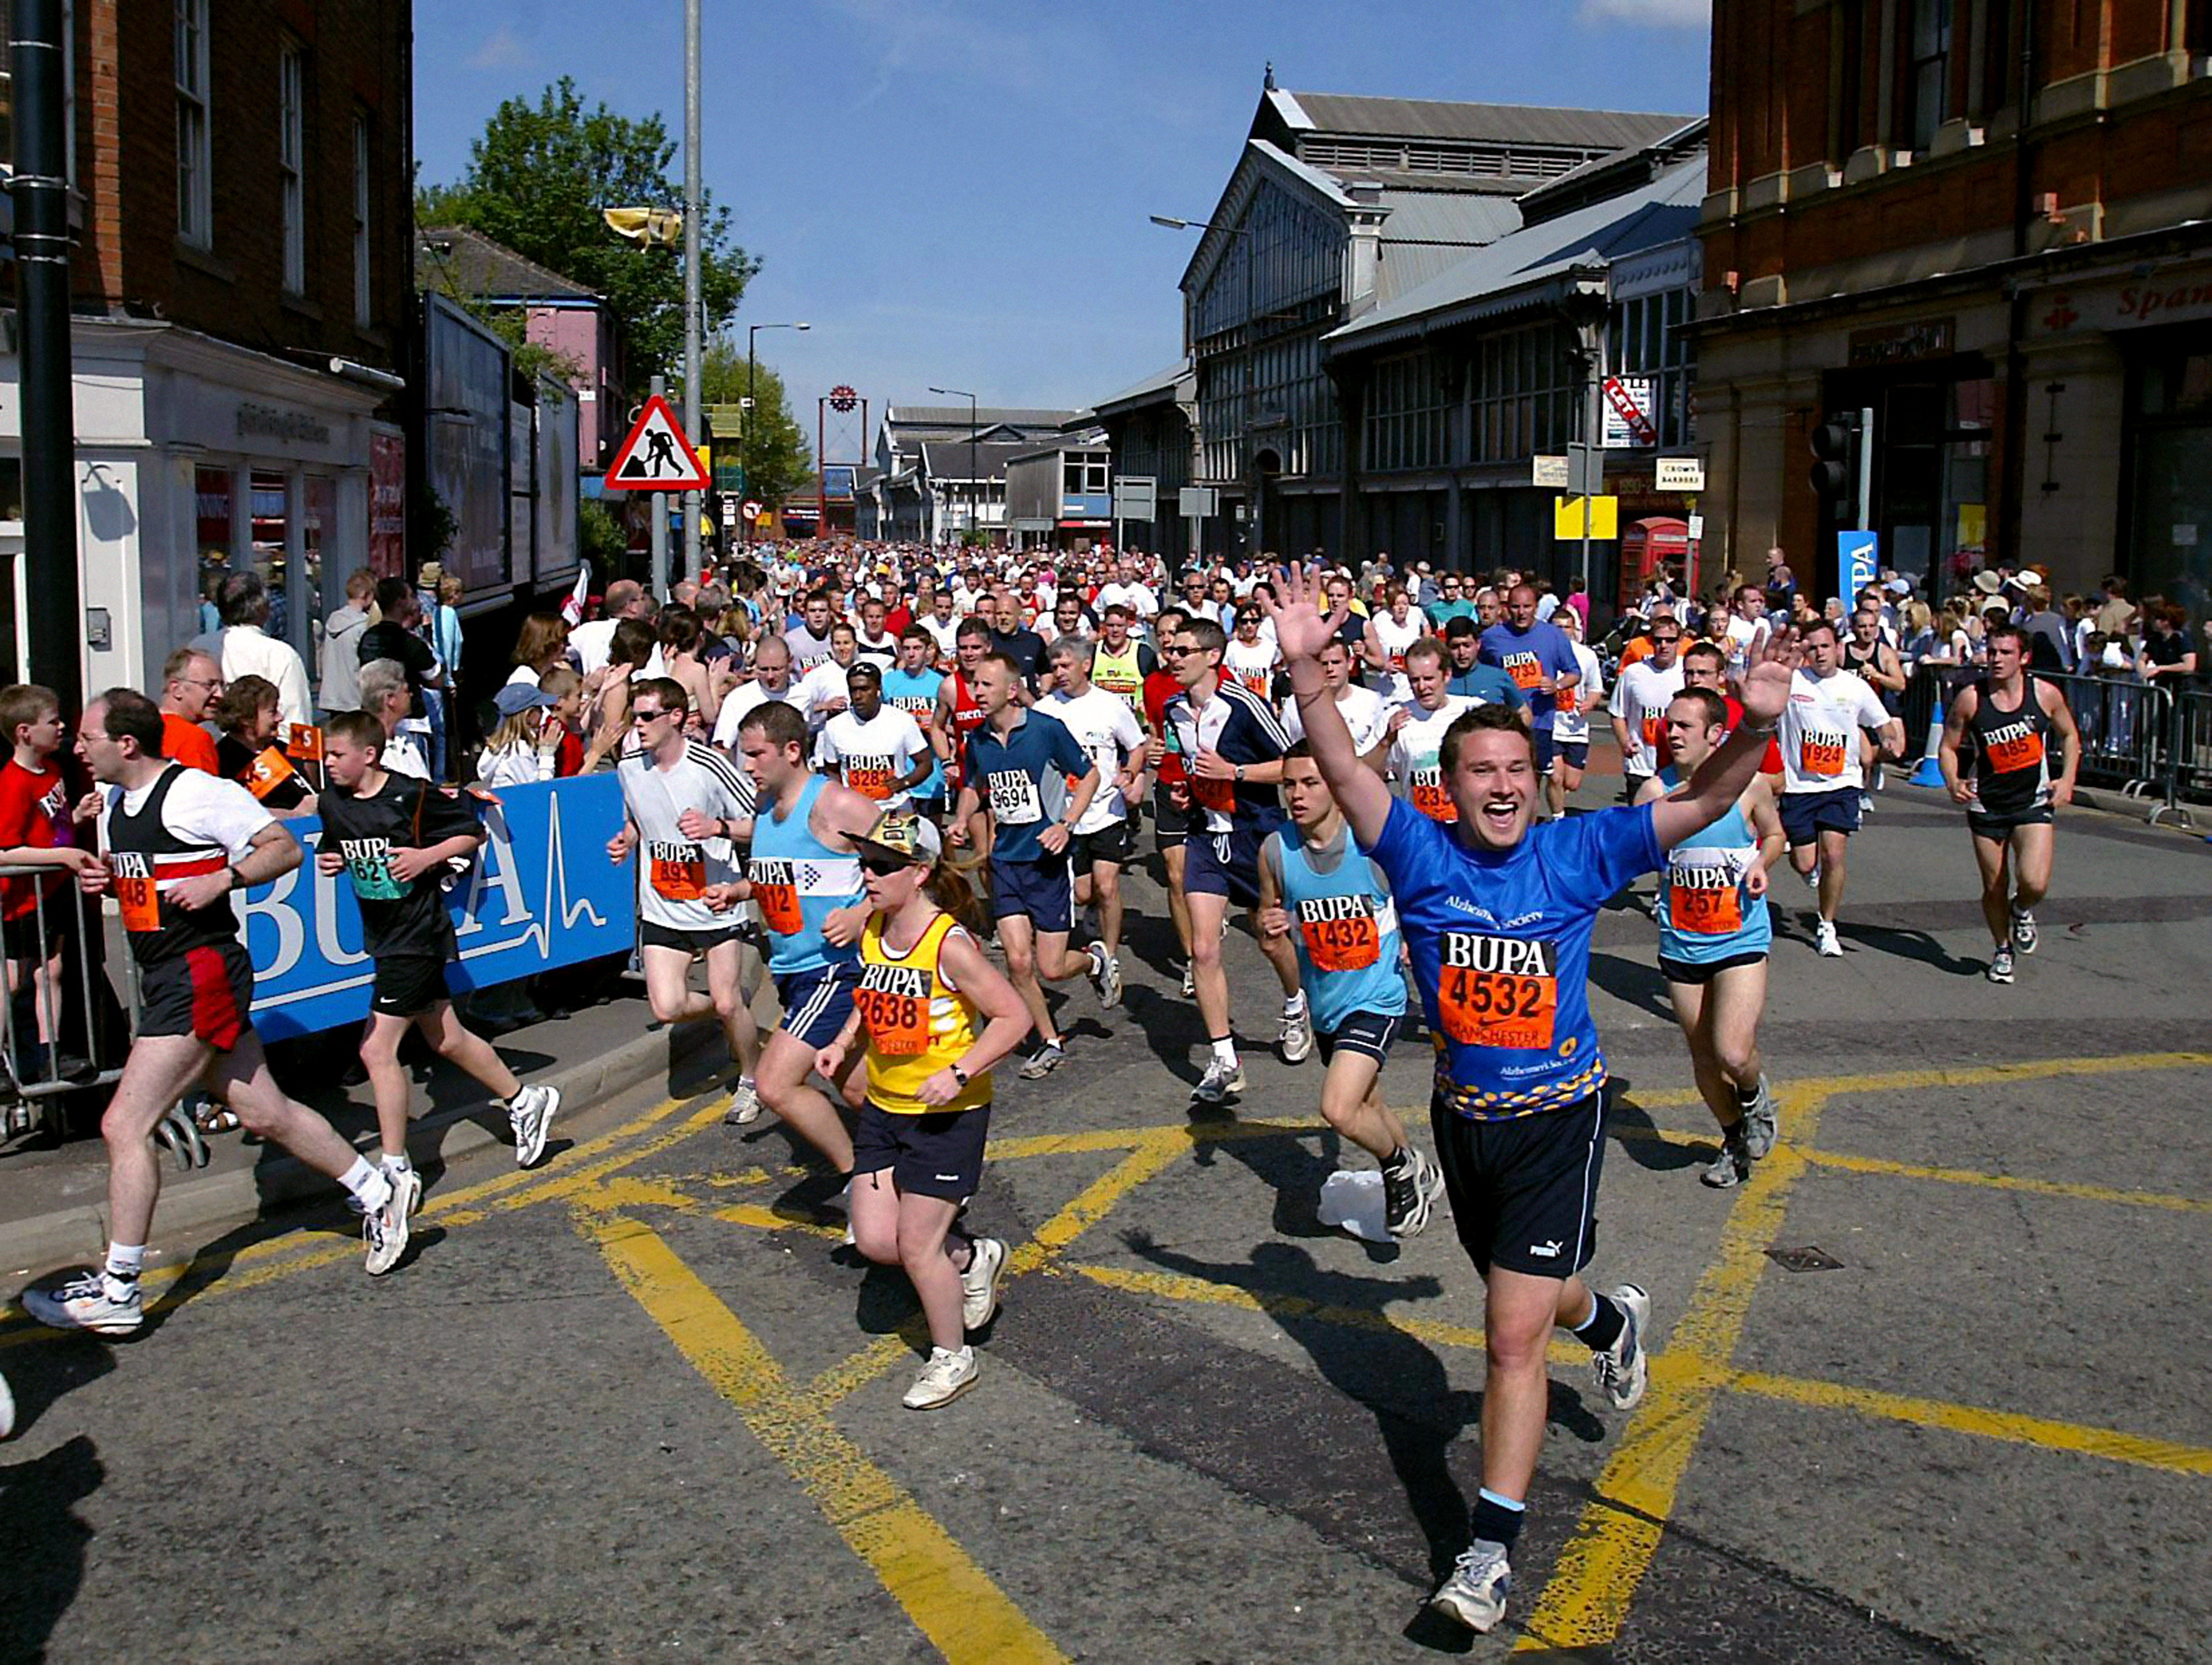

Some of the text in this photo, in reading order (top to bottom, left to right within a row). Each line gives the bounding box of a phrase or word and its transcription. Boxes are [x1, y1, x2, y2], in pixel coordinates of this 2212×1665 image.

[1608, 385, 1634, 413] LET
[1502, 651, 1537, 668] BUPA
[1805, 730, 1843, 747] BUPA
[1984, 721, 2033, 746] BUPA
[849, 755, 892, 770] BUPA
[1805, 744, 1842, 762] 1924
[988, 769, 1032, 788] BUPA
[993, 788, 1030, 808] 9694
[653, 842, 700, 862] BUPA
[1673, 867, 1731, 889] BUPA
[237, 804, 533, 984] BUA
[1684, 890, 1723, 914] 257
[1300, 894, 1368, 923] BUPA
[1311, 919, 1371, 949] 1432
[1446, 932, 1550, 977] BUPA
[858, 964, 926, 998] BUPA
[1449, 970, 1541, 1018] 4532
[858, 991, 917, 1029] 2638
